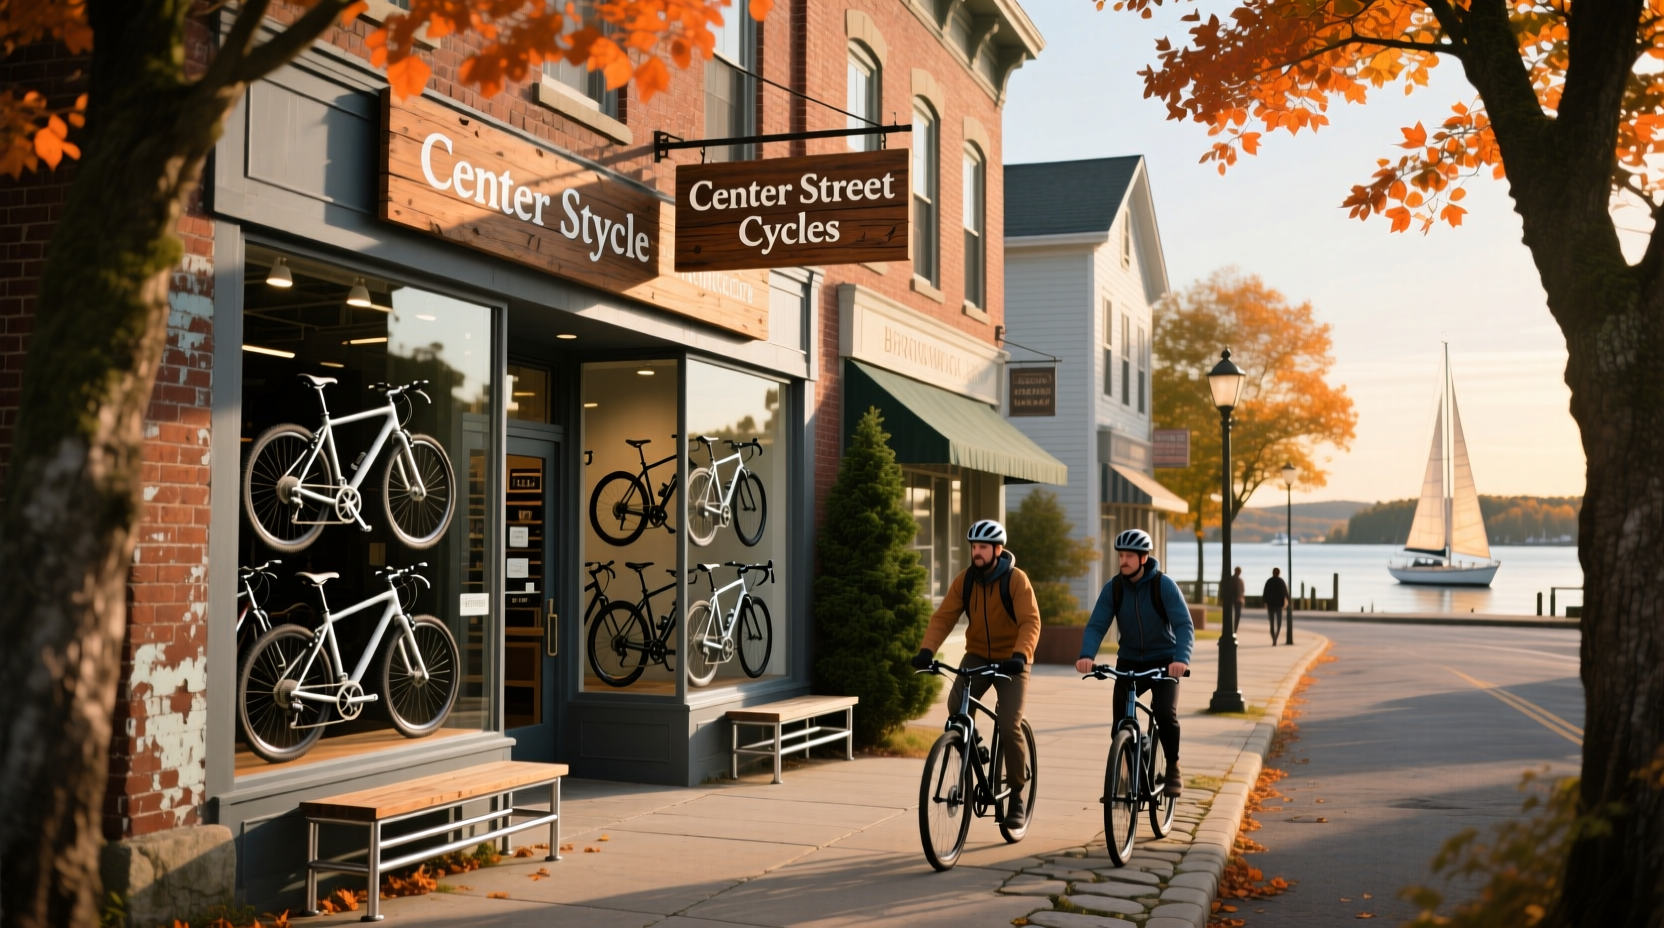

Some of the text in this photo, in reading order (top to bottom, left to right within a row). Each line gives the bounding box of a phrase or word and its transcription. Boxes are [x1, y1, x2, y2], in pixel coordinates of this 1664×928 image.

[421, 133, 650, 262] Center Stycle
[689, 172, 896, 211] Center Street
[738, 211, 840, 255] Cycles
